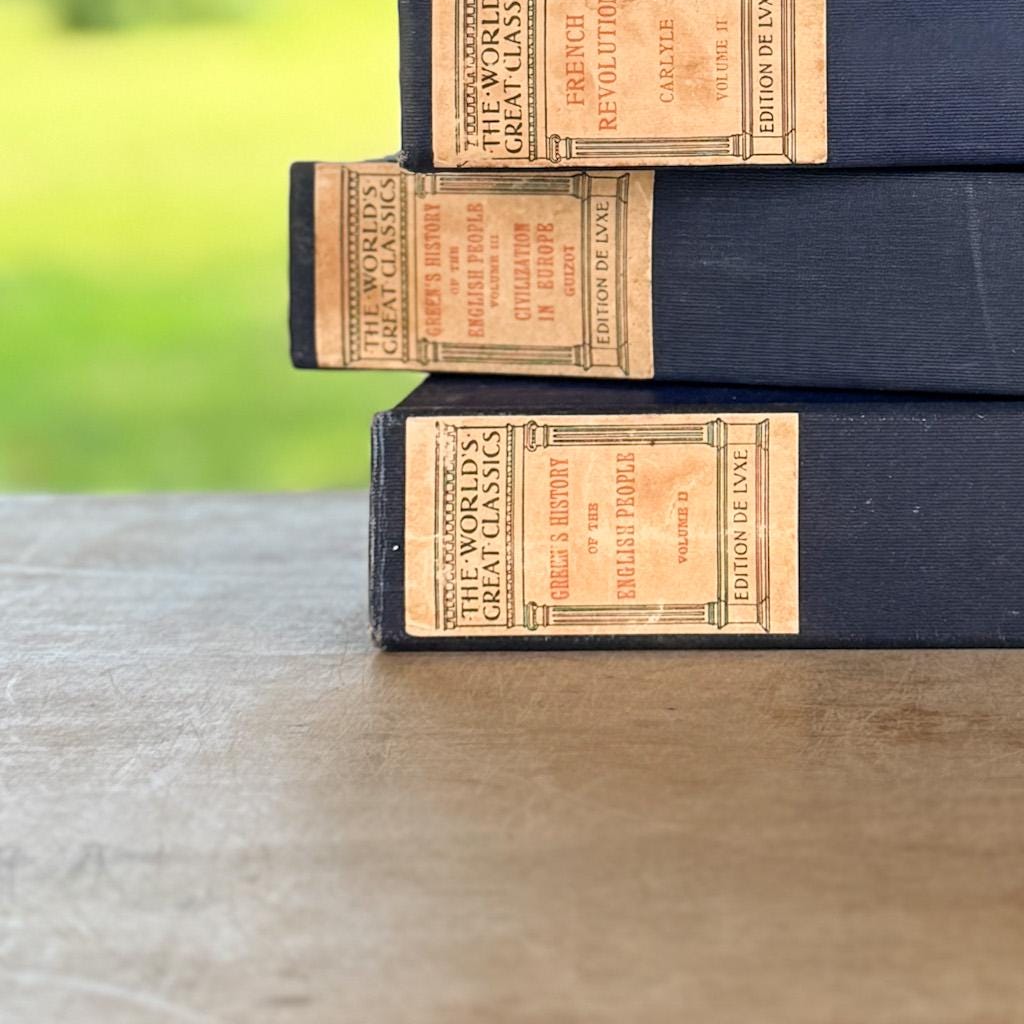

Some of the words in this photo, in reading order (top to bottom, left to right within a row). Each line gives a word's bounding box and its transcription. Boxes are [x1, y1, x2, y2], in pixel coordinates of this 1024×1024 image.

[716, 19, 728, 32] II
[758, 34, 774, 56] DE
[566, 14, 585, 106] FRENCH
[659, 18, 675, 103] CARLYLE
[715, 39, 729, 101] VOLUME
[482, 100, 501, 151] THE
[505, 81, 523, 154] GREAT
[758, 63, 774, 132] EDITION
[424, 202, 442, 267] HISTORY
[449, 246, 459, 272] THE
[467, 202, 484, 263] PEOPLE
[537, 223, 554, 290] EUROPE
[595, 250, 609, 271] DE
[449, 278, 459, 295] OF
[490, 255, 500, 308] VOLUME
[513, 223, 531, 321] CIVILIZATION
[562, 244, 575, 297] GUIZOT
[424, 273, 442, 337] GREEN'S
[467, 269, 485, 337] ENGLISH
[537, 305, 555, 321] IN
[595, 277, 610, 344] EDITION
[482, 430, 501, 541] CLASSICS
[550, 457, 570, 526] HISTORY
[616, 452, 636, 518] PEOPLE
[733, 500, 749, 523] DE
[550, 532, 570, 600] GREEN'S
[588, 536, 599, 554] OF
[616, 525, 636, 599] ENGLISH
[678, 507, 689, 564] VOLUME
[733, 530, 750, 600] EDITION
[460, 568, 479, 618] THE
[482, 547, 501, 621] GREAT
